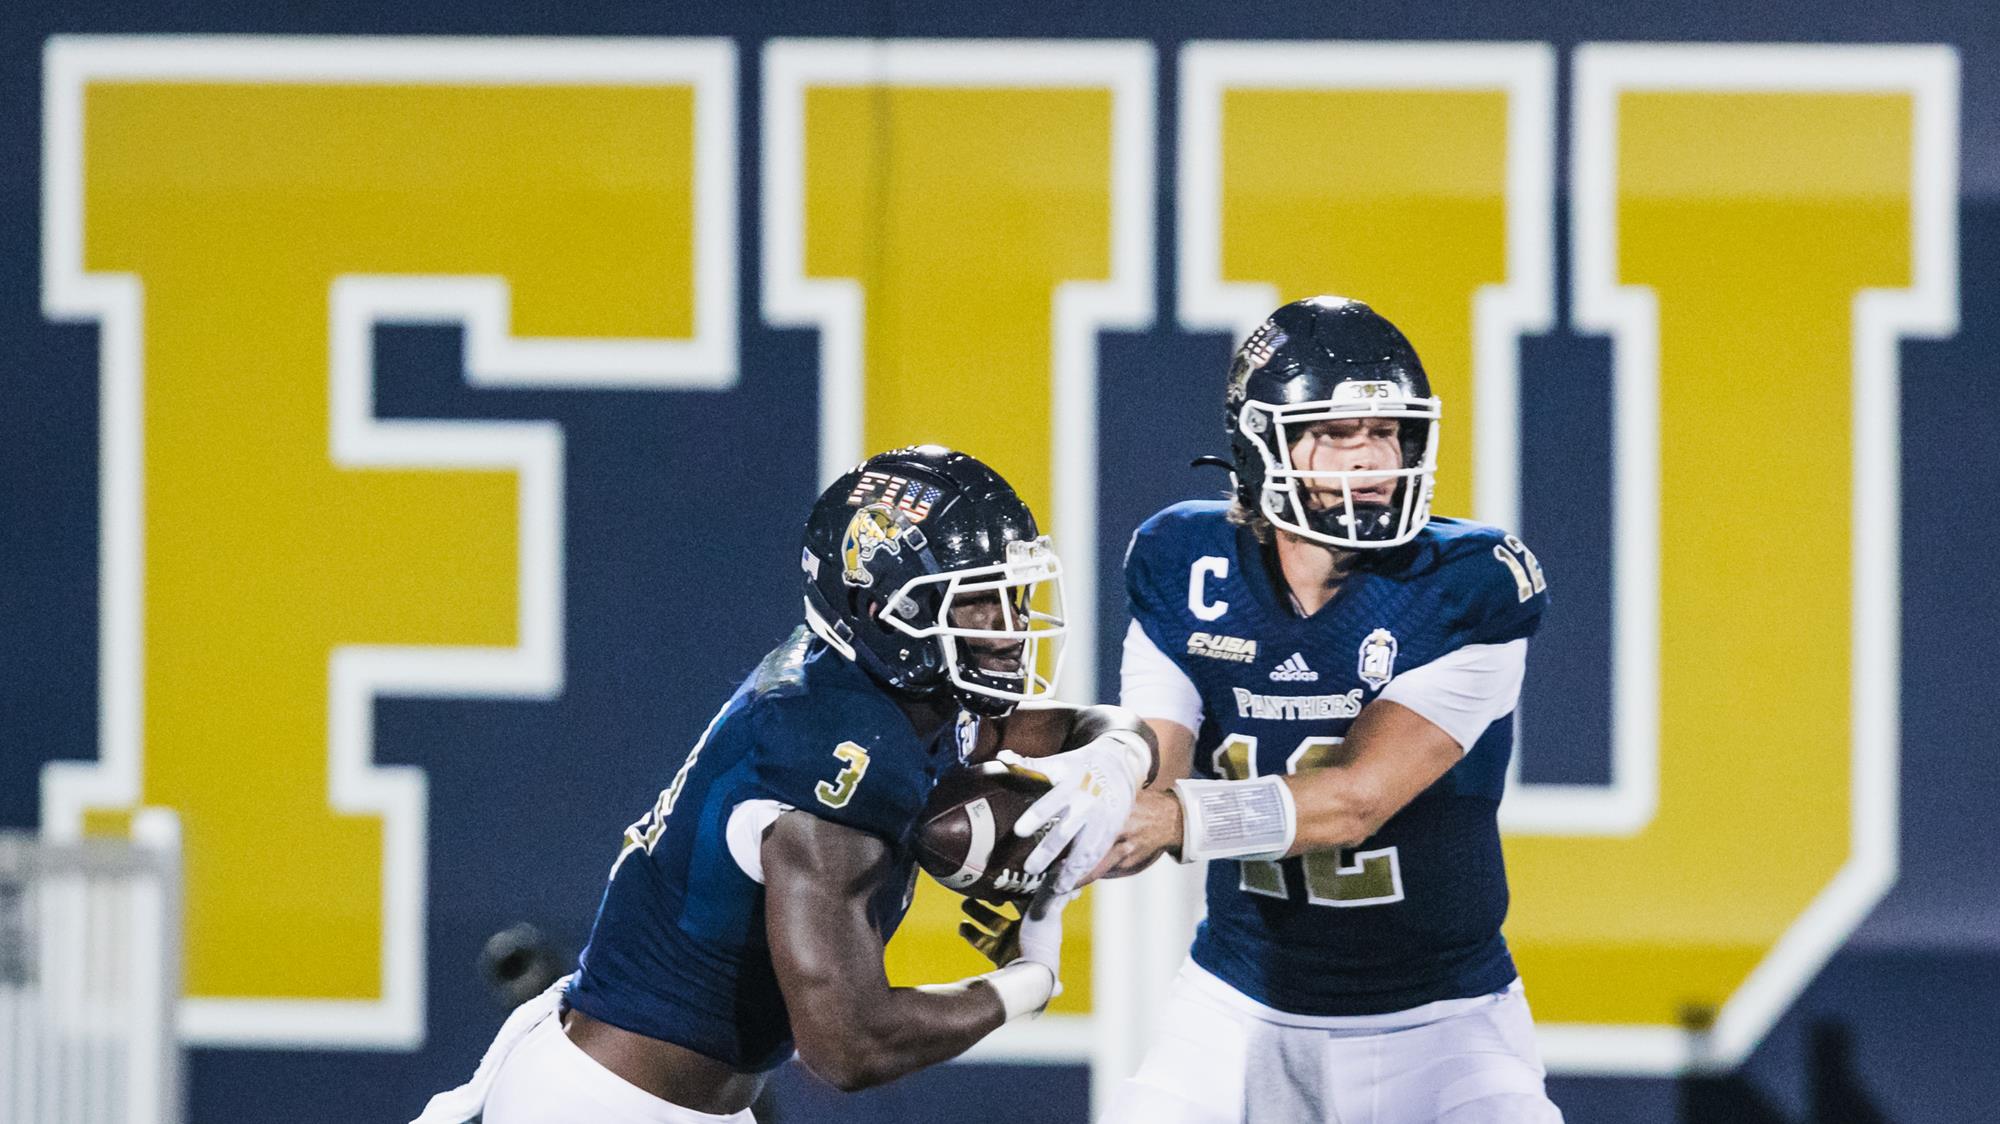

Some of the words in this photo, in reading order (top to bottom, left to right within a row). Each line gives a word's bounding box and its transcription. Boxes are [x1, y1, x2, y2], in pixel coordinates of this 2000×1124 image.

[848, 471, 943, 525] FIU
[43, 35, 1960, 1073] FIU
[1493, 534, 1547, 603] 12
[1188, 555, 1229, 621] C
[1232, 686, 1363, 720] PANTHERS
[1269, 671, 1319, 682] adidas
[815, 740, 870, 808] 3
